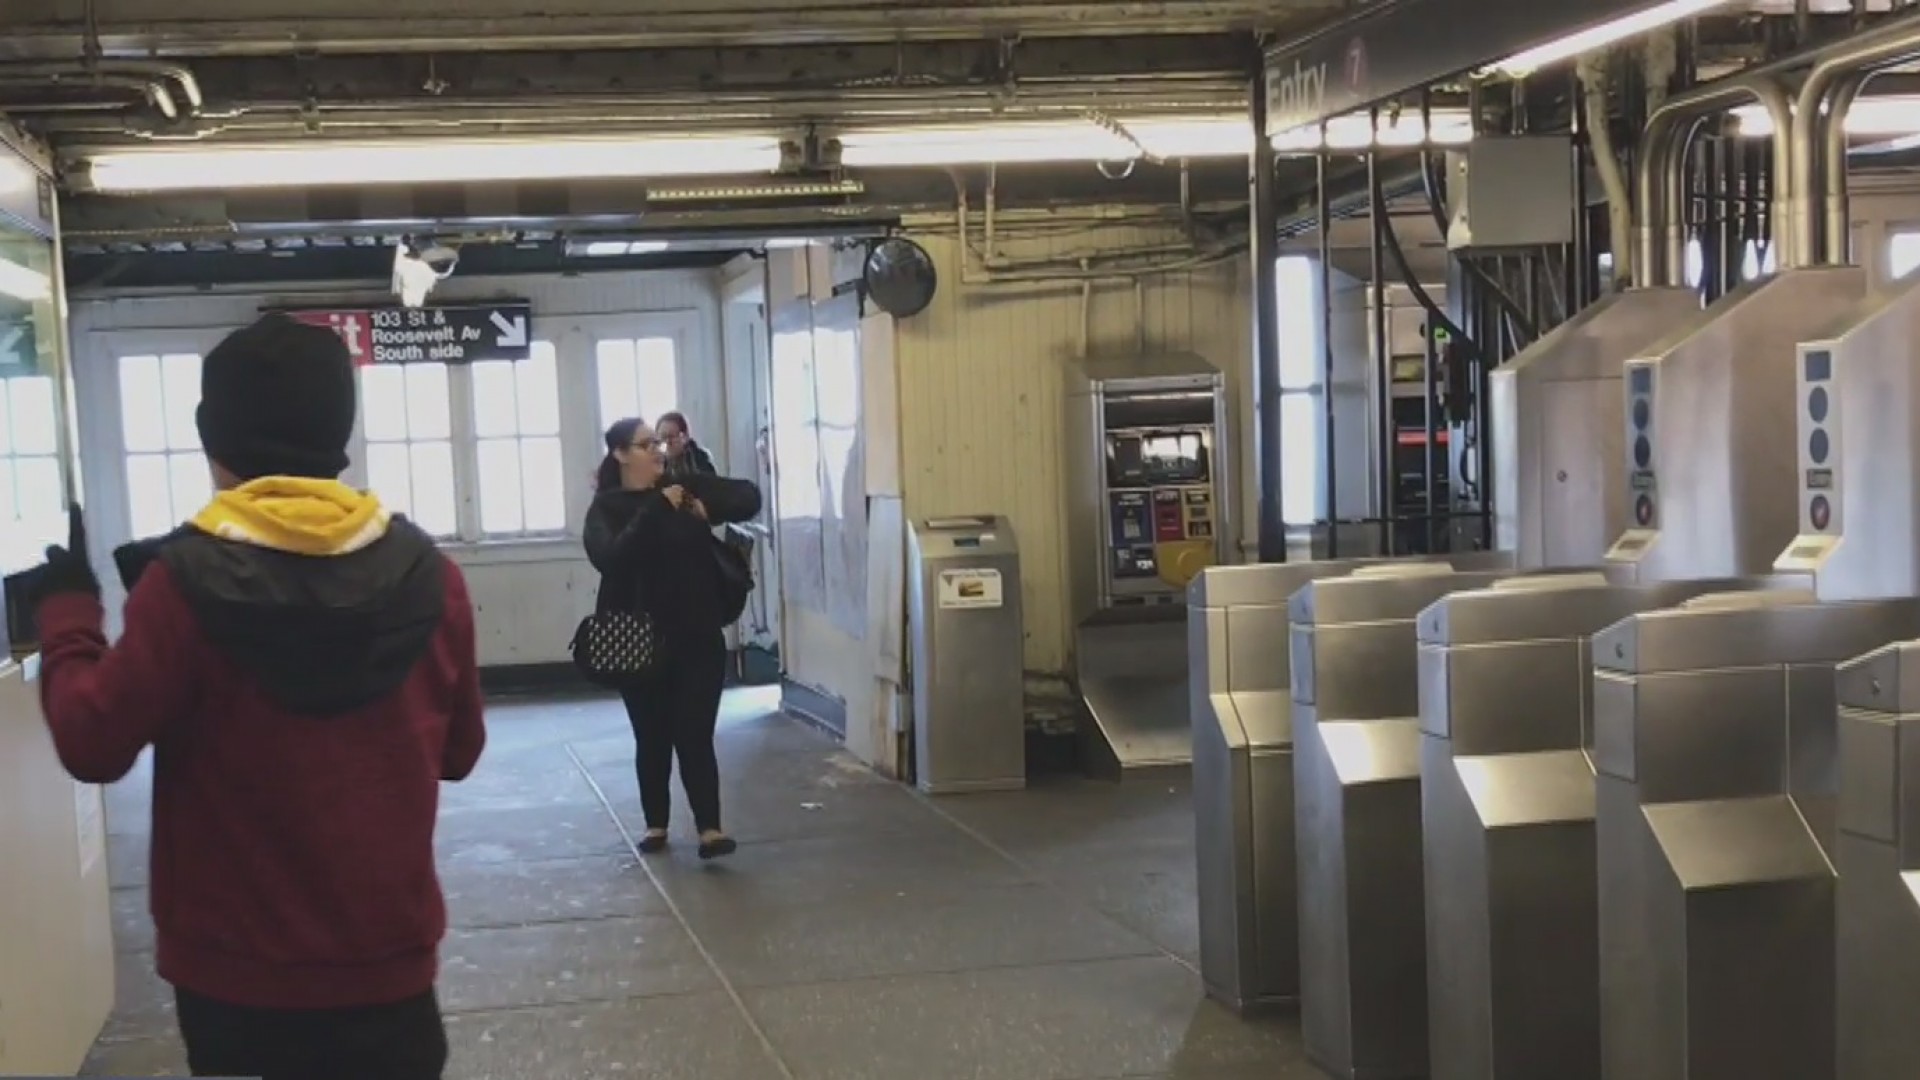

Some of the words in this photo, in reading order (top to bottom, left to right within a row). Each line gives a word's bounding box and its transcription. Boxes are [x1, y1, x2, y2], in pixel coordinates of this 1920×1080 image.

[1265, 60, 1326, 113] Entry
[371, 311, 401, 327] 103
[407, 310, 426, 326] St
[433, 309, 446, 325] &
[371, 326, 455, 343] Roosevelt
[461, 325, 481, 341] Av
[373, 345, 423, 360] South
[429, 342, 464, 360] side
